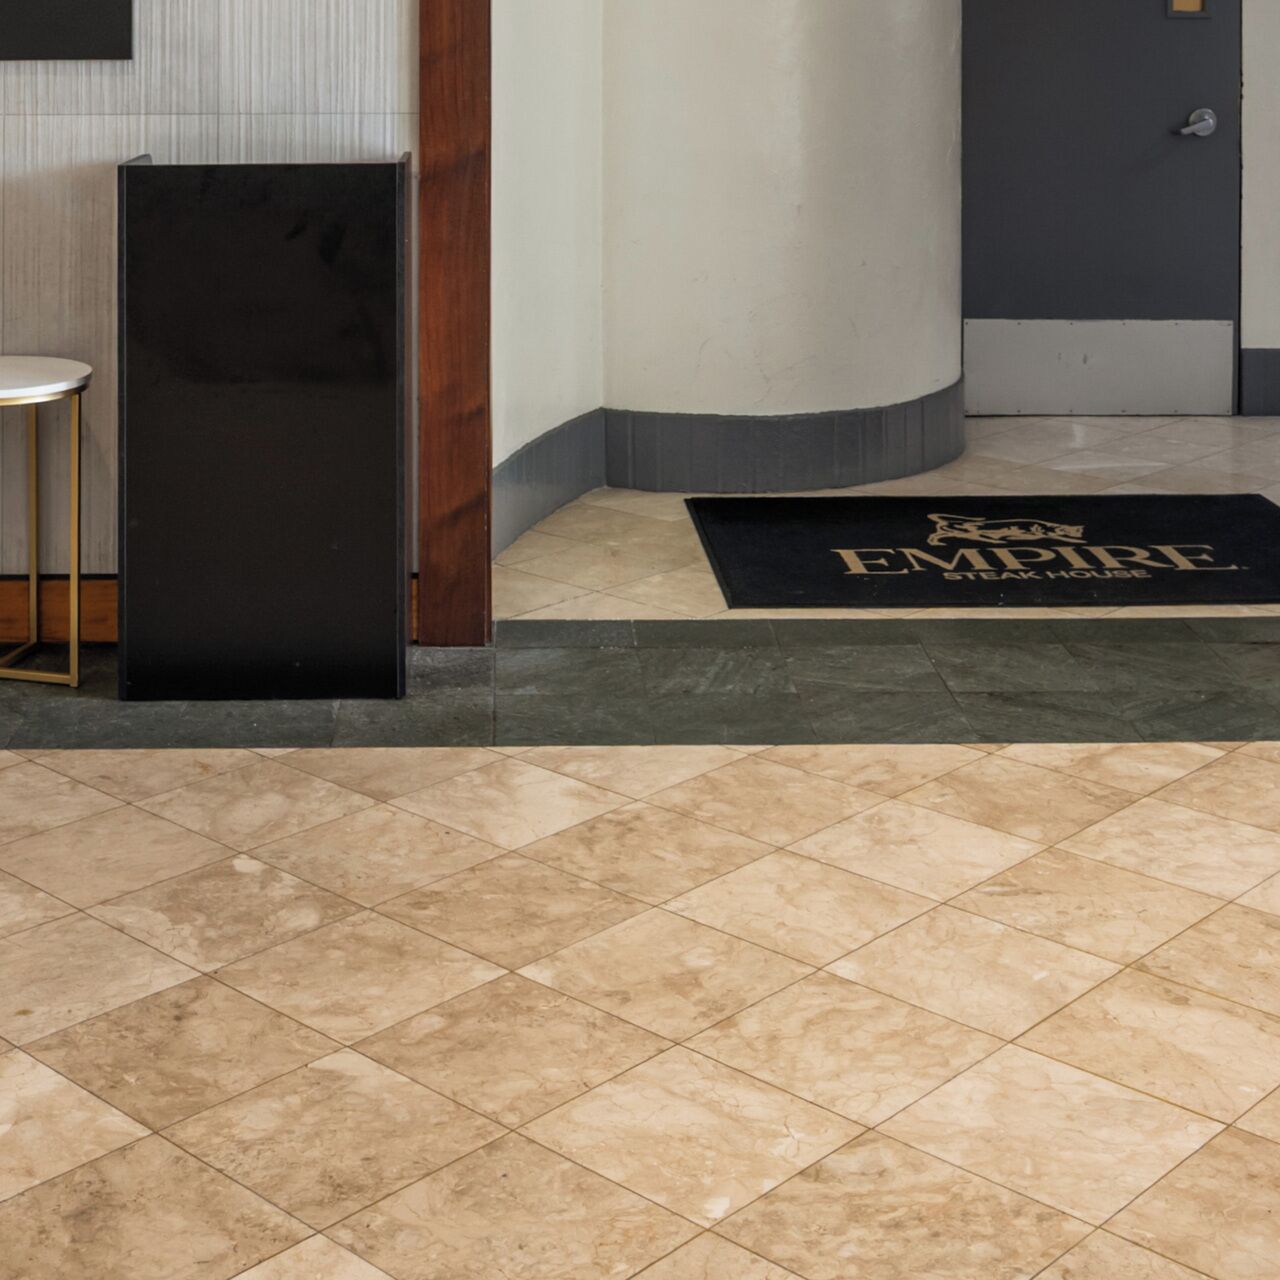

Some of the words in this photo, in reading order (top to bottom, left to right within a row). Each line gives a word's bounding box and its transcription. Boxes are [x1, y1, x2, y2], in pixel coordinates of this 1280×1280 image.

[830, 544, 1239, 575] EMPIRE
[942, 571, 1043, 581] STEAK
[1046, 569, 1153, 579] HOUSE
